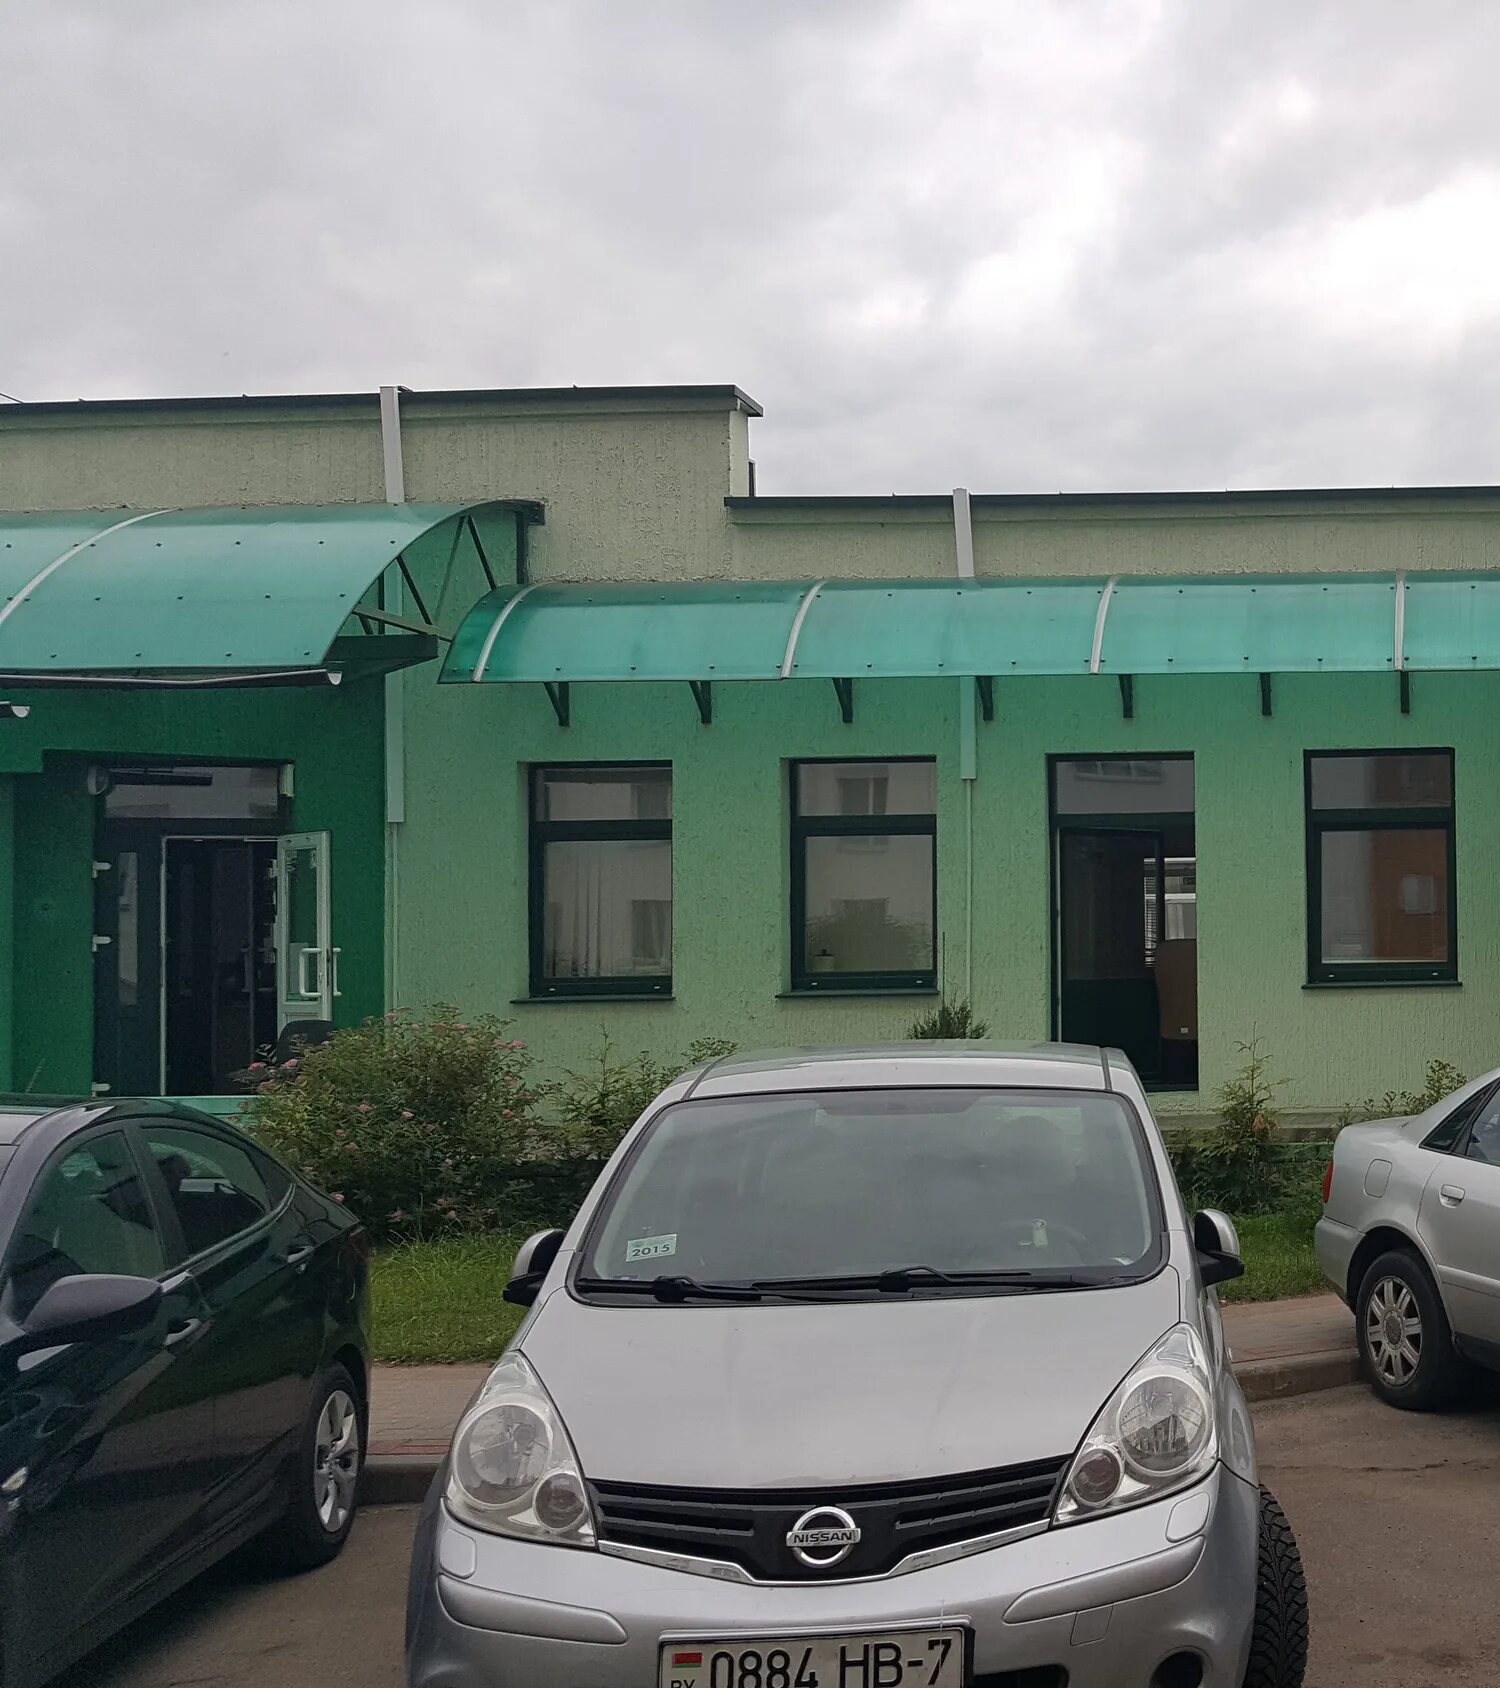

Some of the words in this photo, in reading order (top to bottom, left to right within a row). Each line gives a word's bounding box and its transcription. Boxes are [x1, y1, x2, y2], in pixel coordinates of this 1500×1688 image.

[632, 1244, 670, 1257] 2015
[794, 1532, 852, 1543] NISSAN
[710, 1647, 819, 1688] 0884
[839, 1637, 952, 1688] HB-7
